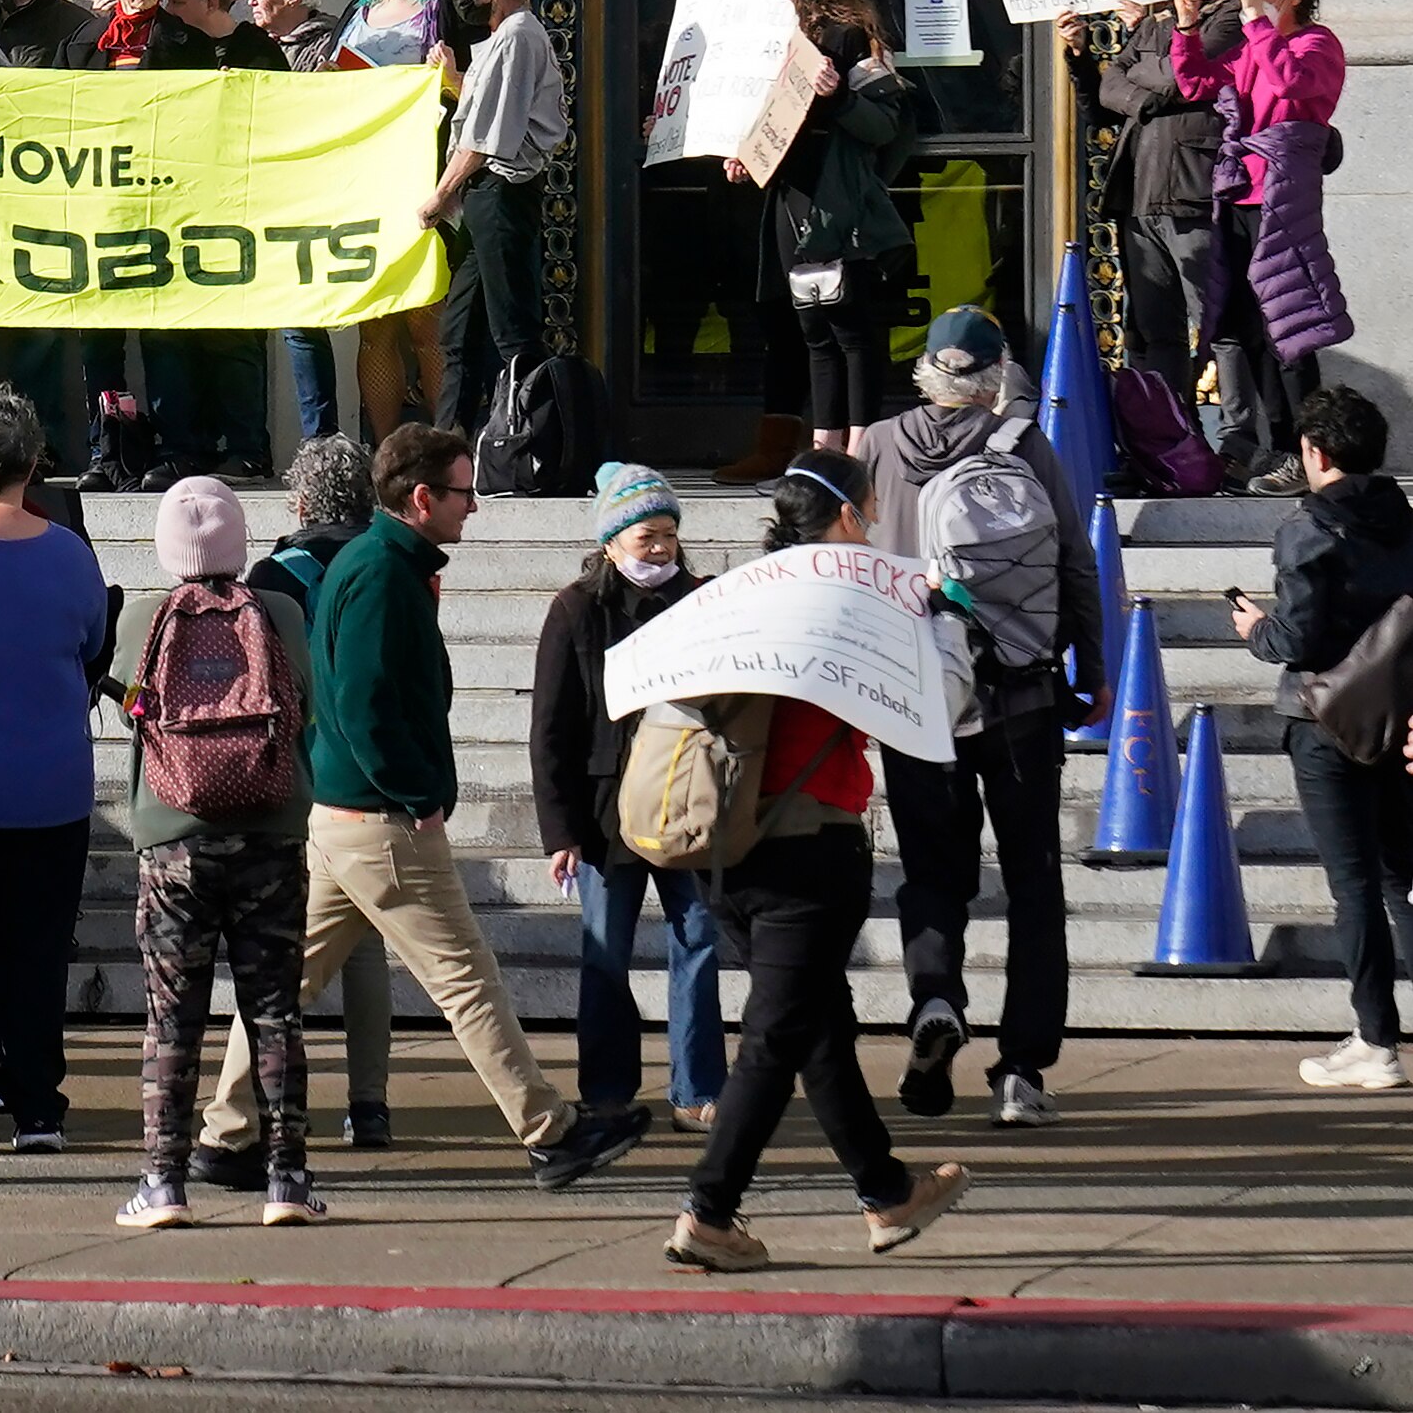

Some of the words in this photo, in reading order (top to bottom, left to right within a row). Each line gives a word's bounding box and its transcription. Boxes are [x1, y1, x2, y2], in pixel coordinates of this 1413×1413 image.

[662, 54, 697, 86] VOTE
[655, 86, 682, 120] NO
[812, 549, 928, 618] CHECKS
